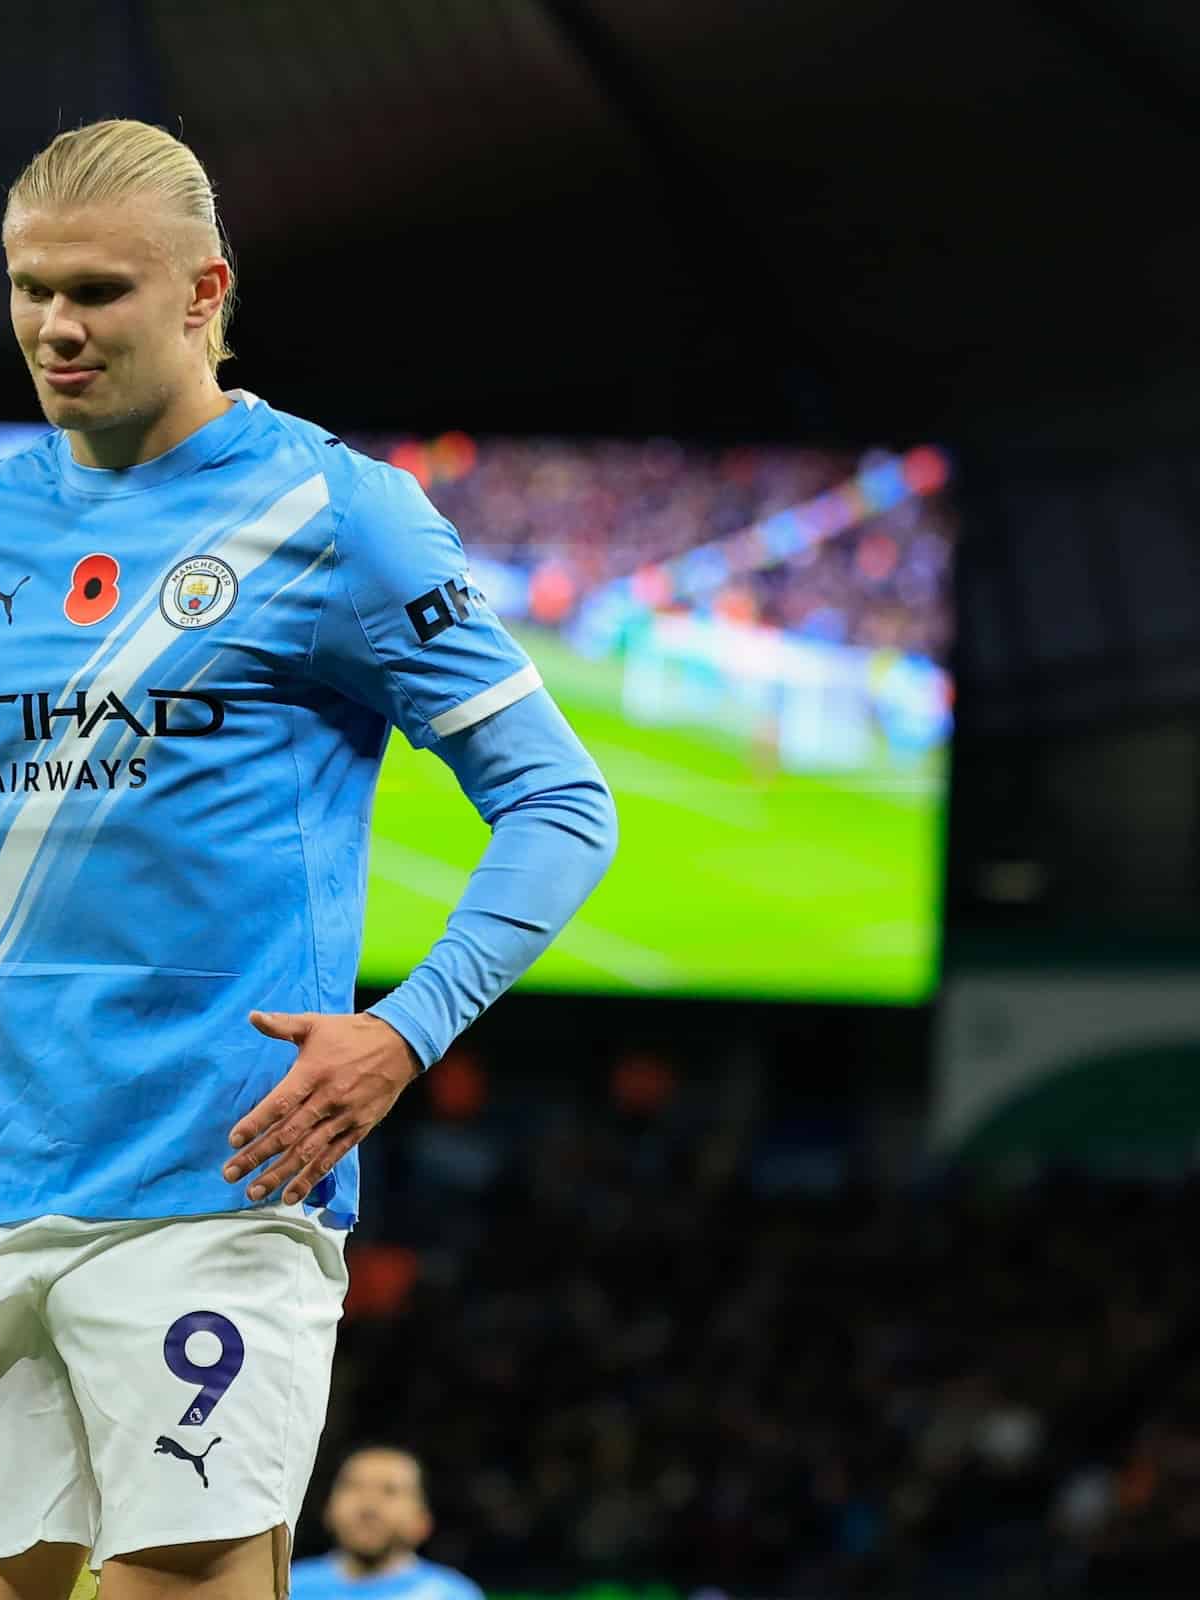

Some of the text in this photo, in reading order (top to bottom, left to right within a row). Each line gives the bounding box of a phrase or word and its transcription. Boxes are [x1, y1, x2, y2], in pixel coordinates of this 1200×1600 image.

[171, 561, 231, 586] MANCHESTER
[180, 616, 202, 625] CITY
[163, 1310, 245, 1426] 9
